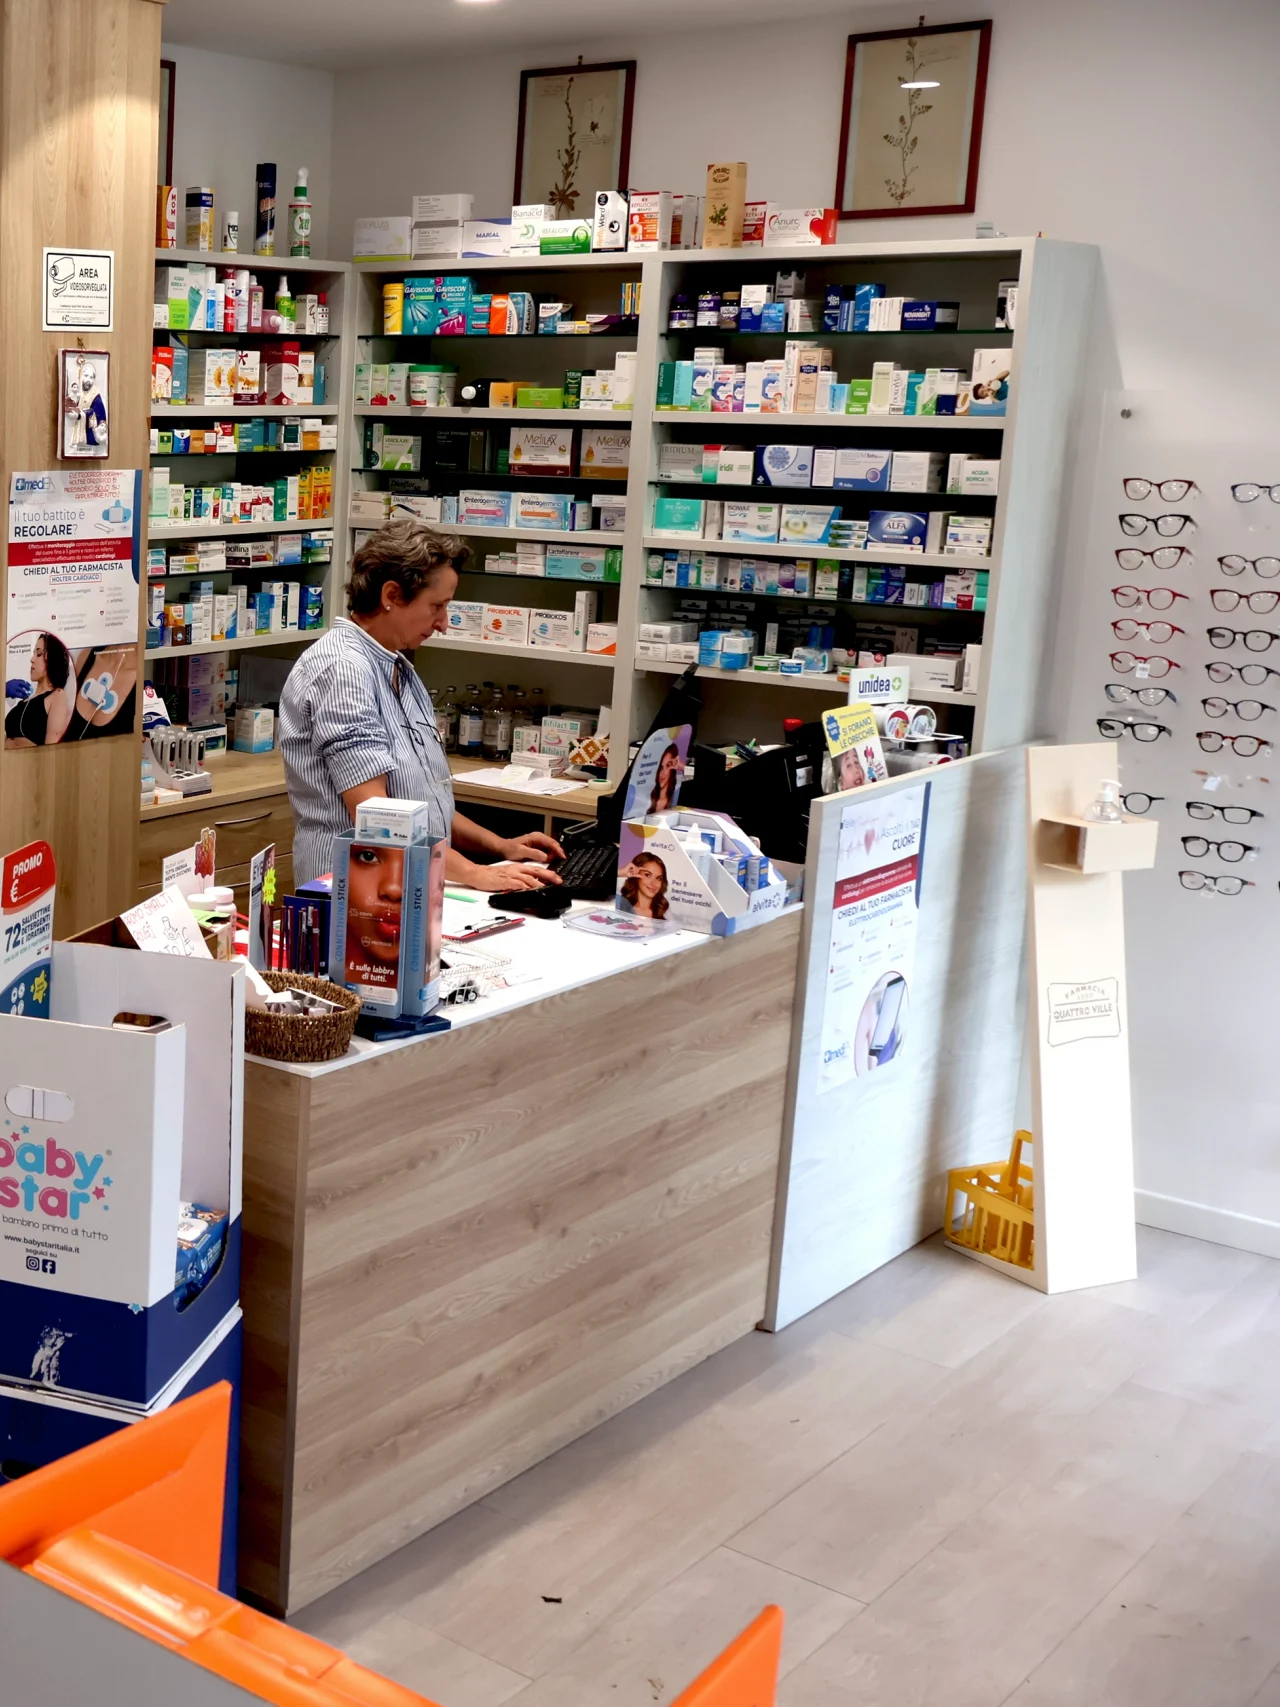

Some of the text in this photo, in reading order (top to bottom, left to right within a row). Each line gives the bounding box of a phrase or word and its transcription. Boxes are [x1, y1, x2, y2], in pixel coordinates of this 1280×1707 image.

[513, 209, 542, 218] Bianacid
[79, 268, 98, 278] AREA
[70, 282, 107, 292] VIDEOSORVEGLIATA
[404, 286, 434, 294] GAVISCON
[436, 284, 467, 293] GAVISCON
[14, 511, 20, 522] Il
[23, 512, 40, 522] tuo
[44, 510, 76, 520] battito
[14, 524, 78, 537] REGOLARE?
[886, 522, 906, 530] ALFA
[79, 563, 123, 571] FARMACISTA
[859, 674, 890, 693] unidea
[543, 718, 569, 730] Bifilact
[842, 727, 848, 736] SI
[848, 717, 871, 734] FORANO
[840, 739, 847, 749] LE
[848, 727, 875, 746] ORECCHIE
[542, 746, 567, 756] Bifilact
[12, 852, 43, 879] PROMO
[672, 879, 682, 887] Per
[672, 888, 702, 898] benessere
[695, 899, 711, 908] occhi
[753, 898, 772, 913] alvita
[838, 886, 913, 920] CHIEDI AL TUO FARMACISTA
[5, 923, 21, 952] 72
[22, 904, 51, 926] SALVIETTINE
[21, 914, 50, 935] DETERGENTI
[26, 923, 50, 942] IDRATANTI
[355, 963, 370, 972] sulle
[373, 965, 394, 975] labbra
[370, 974, 387, 982] tutti.
[1065, 985, 1105, 999] FARMACIA
[1054, 1003, 1112, 1019] QUATTRO VILLE
[2, 1213, 40, 1229] bambino
[42, 1223, 69, 1235] prima
[72, 1225, 79, 1235] di
[81, 1228, 108, 1241] tutto
[4, 1234, 80, 1253] www.babystaritalia.it
[25, 1248, 48, 1257] seguici
